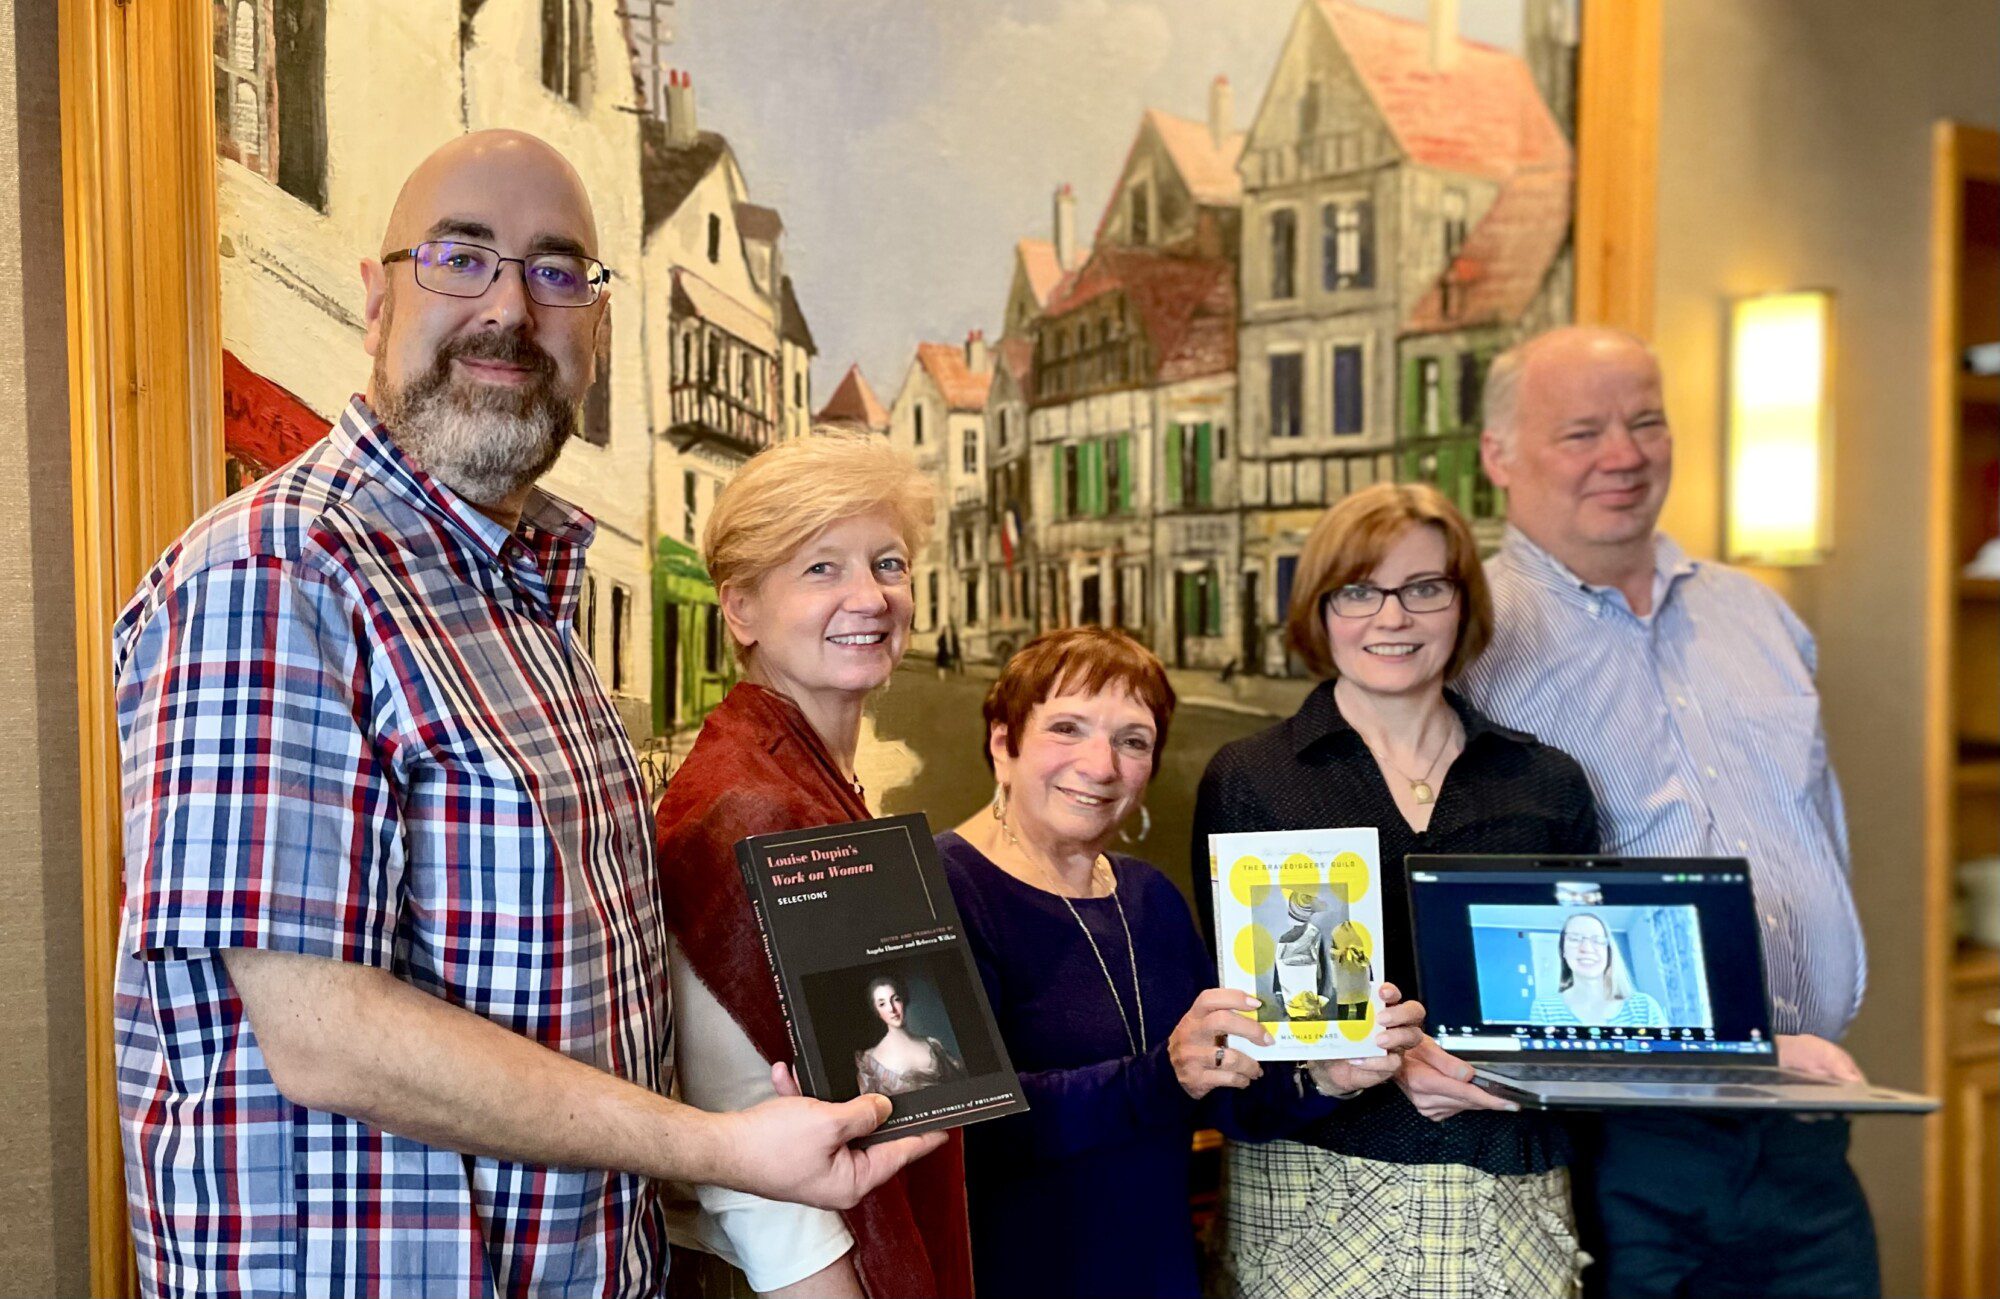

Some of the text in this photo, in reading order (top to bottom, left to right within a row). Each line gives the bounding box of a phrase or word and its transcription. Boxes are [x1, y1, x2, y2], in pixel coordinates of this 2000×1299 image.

[766, 844, 859, 868] Louise Dupin's
[771, 871, 805, 887] Work
[808, 870, 825, 881] on
[827, 863, 874, 878] Women
[777, 890, 828, 906] SELECTIONS
[904, 940, 915, 948] and
[887, 1115, 914, 1125] OXFORD
[915, 1111, 929, 1120] NEW
[931, 1103, 965, 1115] HISTORIES
[974, 1092, 1014, 1105] PHILOSOPHY
